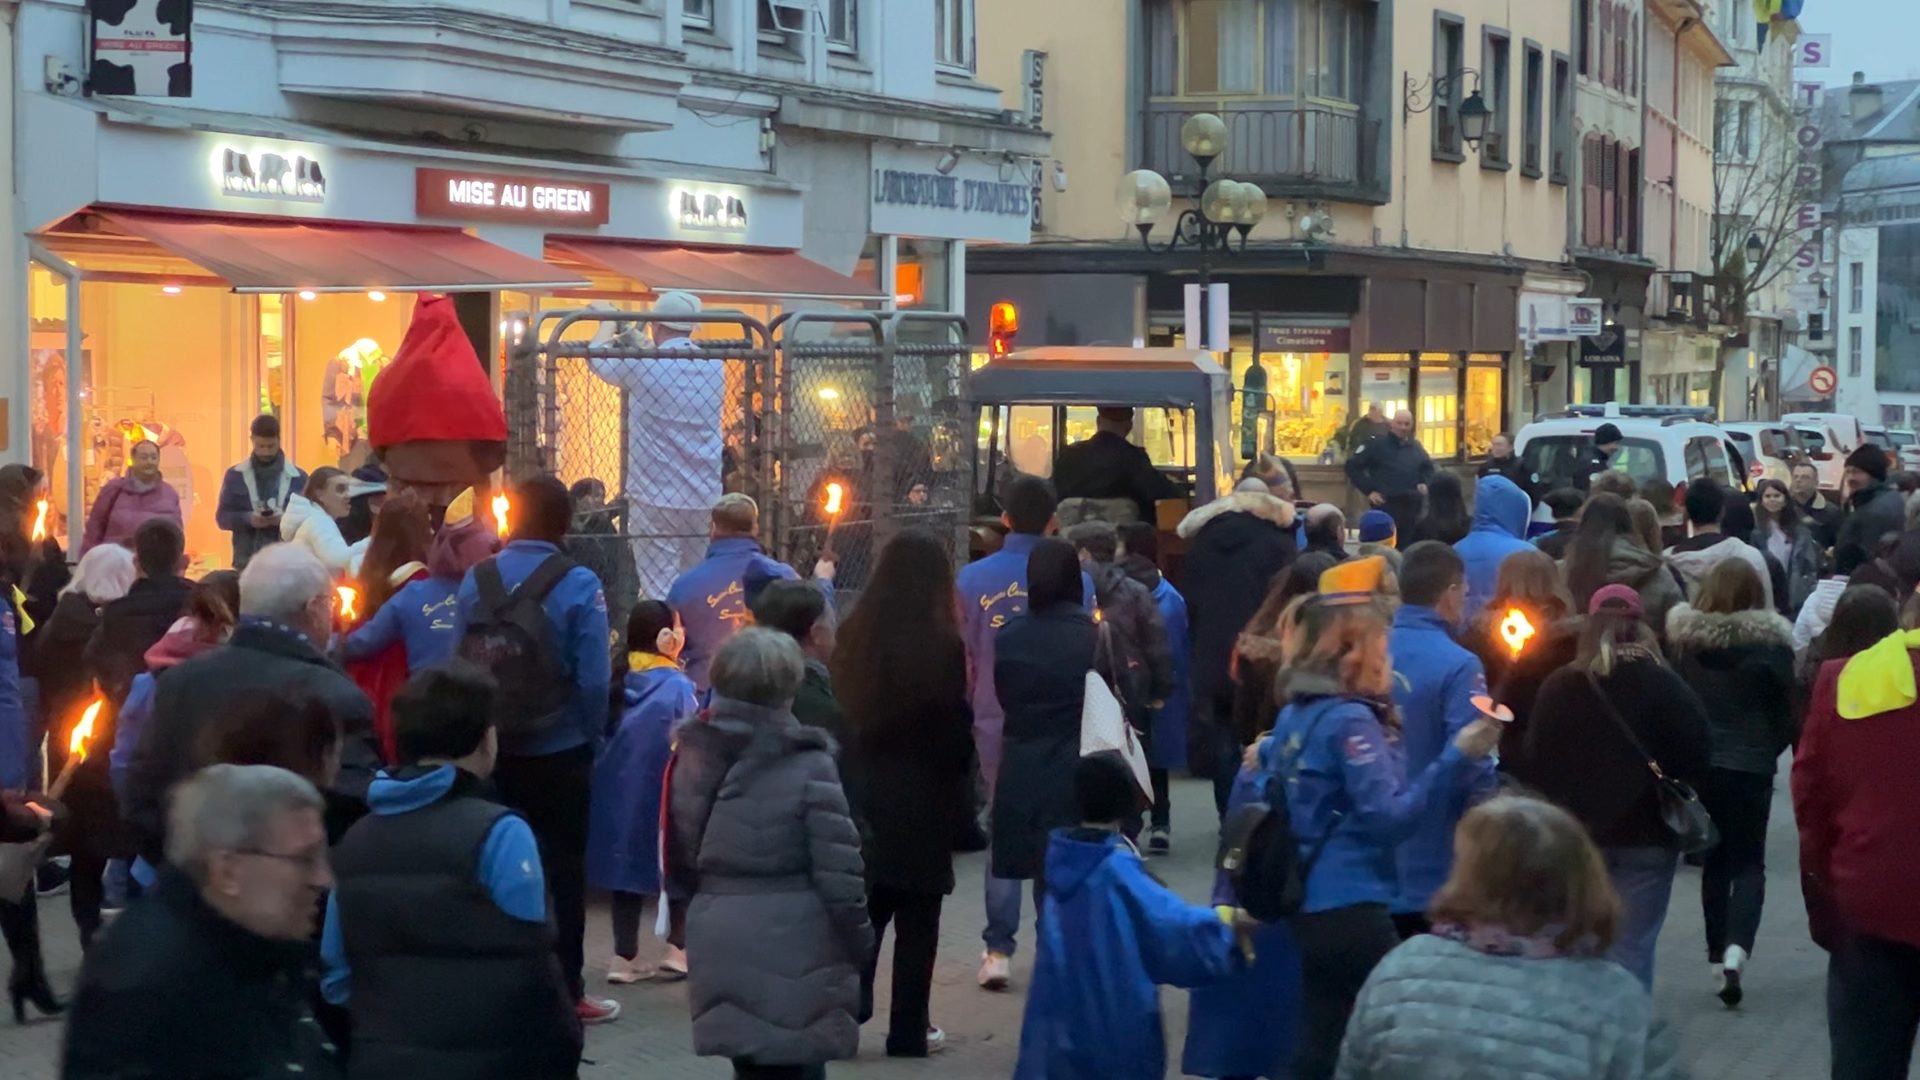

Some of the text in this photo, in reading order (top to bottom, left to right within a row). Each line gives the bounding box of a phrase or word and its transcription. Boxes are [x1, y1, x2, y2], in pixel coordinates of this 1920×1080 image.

[1797, 41, 1821, 268] STORES
[449, 179, 591, 212] MISE AU GREEN
[874, 168, 1029, 216] LABORATOIRE D'ANALYSES
